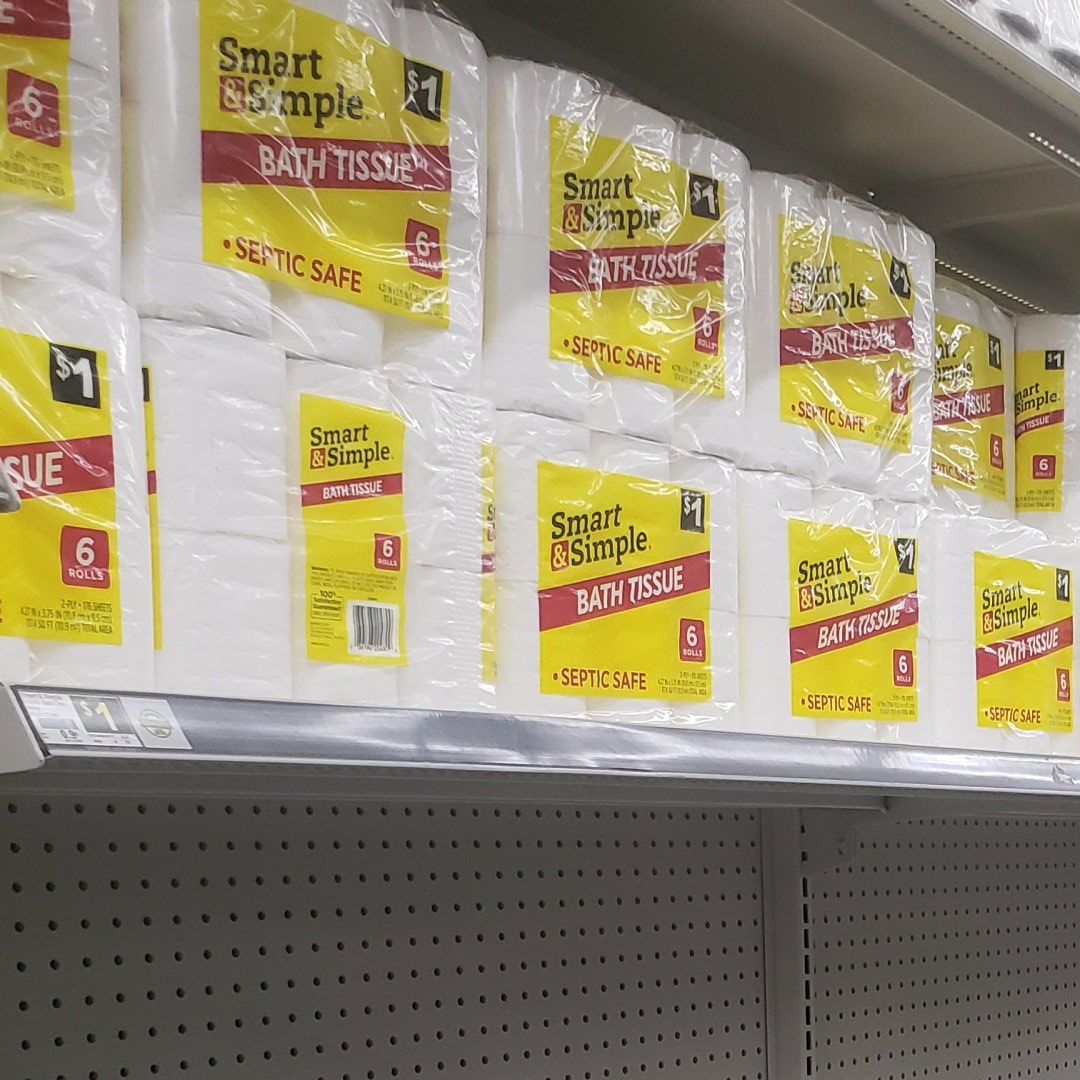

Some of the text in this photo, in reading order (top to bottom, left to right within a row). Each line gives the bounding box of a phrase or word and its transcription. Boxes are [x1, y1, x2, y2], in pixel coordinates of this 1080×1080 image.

[219, 37, 322, 79] Smart
[23, 86, 43, 118] 6
[406, 69, 439, 121] $1
[259, 145, 414, 183] BATH TISSUE
[564, 172, 633, 200] Smart
[691, 180, 716, 214] $1
[415, 230, 430, 257] 6
[235, 236, 363, 294] SEPTIC SAFE
[588, 251, 698, 284] BATH TISSUE
[702, 313, 712, 337] 6
[572, 335, 662, 374] SEPTIC SAFE
[812, 330, 847, 356] BATH
[989, 340, 1000, 368] $1
[1047, 354, 1062, 368] $1
[55, 354, 95, 399] $1
[798, 401, 835, 426] SEPTIC
[838, 408, 865, 433] SAFE
[1026, 415, 1050, 430] TISSUE
[310, 424, 369, 447] Smart
[993, 440, 999, 457] 6
[1039, 459, 1048, 471] 6
[322, 480, 383, 499] BATH TISSUE
[551, 503, 622, 539] Smart
[683, 495, 702, 527] $1
[76, 537, 94, 567] 6
[382, 539, 393, 557] 6
[898, 543, 914, 569] $1
[68, 568, 104, 582] ROLLS
[798, 555, 850, 584] Smart
[577, 565, 684, 615] BATH TISSUE
[982, 581, 1023, 610] Smart
[1057, 574, 1069, 598] $1
[686, 625, 697, 647] 6
[818, 606, 900, 648] BATH TISSUE
[683, 648, 703, 657] ROLLS
[998, 628, 1059, 667] BATH TISSUE
[898, 655, 907, 674] 6
[561, 667, 610, 688] SEPTIC
[613, 672, 647, 691] SAFE
[1060, 674, 1067, 690] 6
[80, 701, 119, 732] $1
[807, 695, 845, 712] SEPTIC
[847, 696, 871, 713] SAFE
[989, 709, 1019, 723] SEPTIC
[1020, 709, 1041, 724] SAFE
